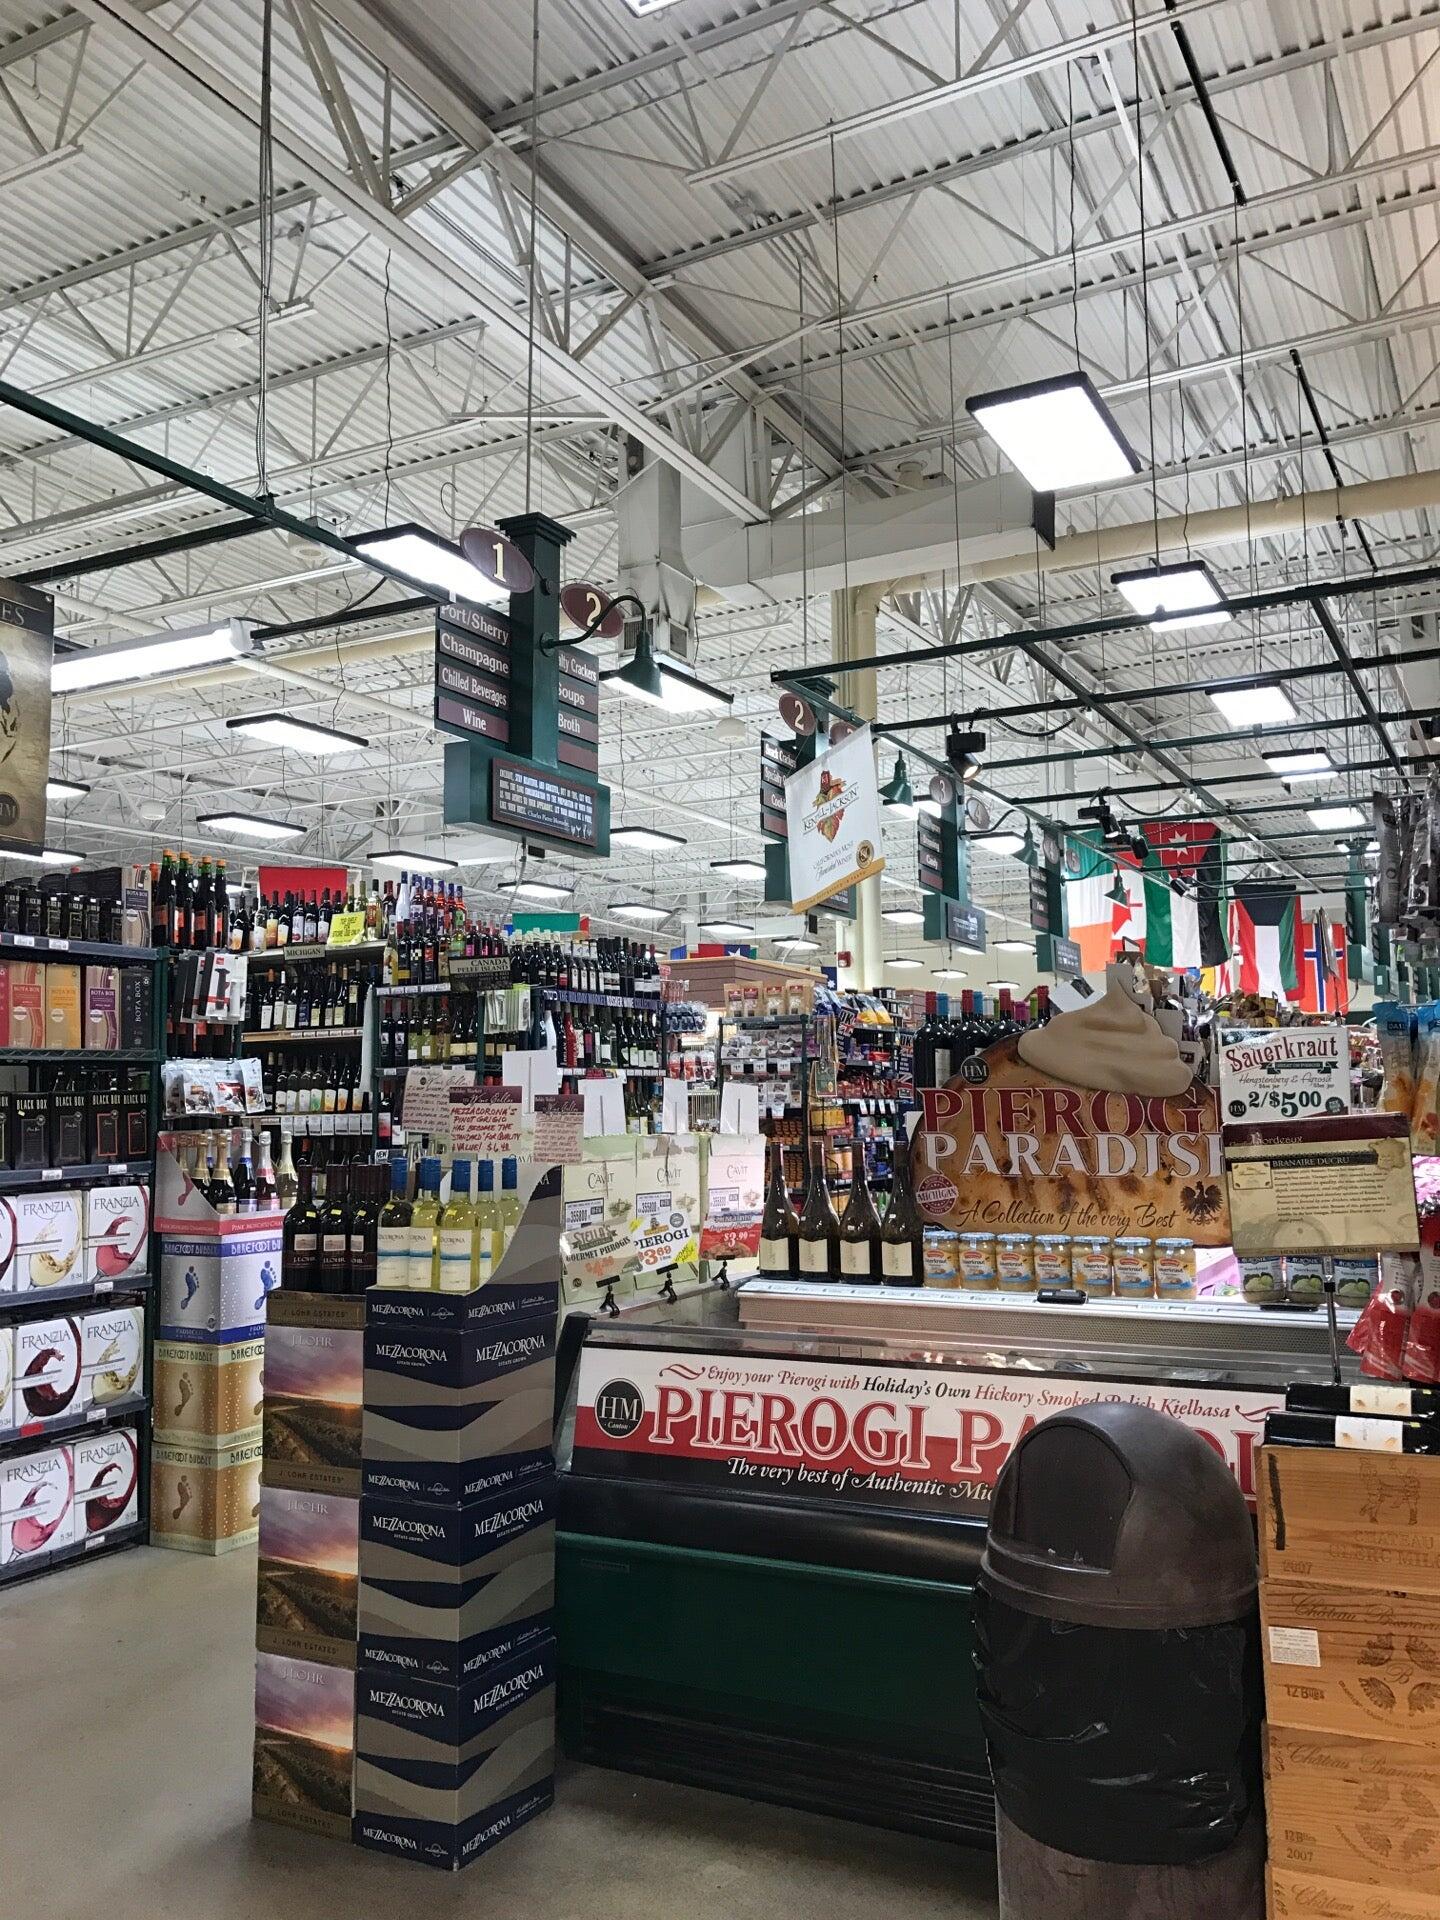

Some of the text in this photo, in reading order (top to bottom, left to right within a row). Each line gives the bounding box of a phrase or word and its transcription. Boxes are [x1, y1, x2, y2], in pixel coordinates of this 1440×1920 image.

[493, 542, 507, 583] 1
[585, 592, 602, 631] 2
[441, 605, 510, 646] Port/Sherry
[440, 632, 510, 675] Champagne
[570, 655, 597, 682] Crackers
[441, 667, 508, 707] Chilled Beverages
[462, 707, 487, 732] Wine
[558, 713, 581, 735] Broth
[793, 700, 805, 731] 2
[771, 793, 786, 809] Cooki
[939, 779, 946, 804] 3
[286, 948, 322, 957] MICHIGAN
[134, 981, 142, 1022] BOTA BOX
[1225, 1036, 1339, 1073] Sauerkraut
[964, 1064, 988, 1078] HM
[1239, 1073, 1290, 1087] Hengstenberg
[16, 1099, 48, 1110] BLACK BOX
[55, 1096, 85, 1107] BLACK BOX
[92, 1095, 121, 1105] BLACK BOX
[123, 1095, 139, 1105] BLACK
[454, 1116, 476, 1124] PINOT
[917, 1086, 1223, 1139] PIEROGI
[1272, 1156, 1351, 1168] BRANAIRE DUCRU
[93, 1196, 140, 1214] FRANZIA
[917, 1187, 958, 1203] MICHIGAN
[23, 1200, 72, 1220] FRANZIA
[957, 1199, 1180, 1237] A Collection of the very Best
[232, 1240, 270, 1255] BAREFOOT
[600, 1236, 631, 1257] PIEROGIS
[634, 1229, 690, 1249] PIEROGI
[372, 1303, 425, 1319] MEZZACORONA
[467, 1300, 516, 1319] MEZZACORONA
[22, 1329, 71, 1350] FRANZIA
[87, 1319, 134, 1340] FRANZIA
[159, 1348, 190, 1360] BAREFOOT
[231, 1345, 265, 1361] BAREFOO
[375, 1343, 448, 1365] MEZZACORONA
[475, 1334, 546, 1363] MEZZACORONA
[706, 1365, 741, 1386] Enjoy
[742, 1370, 774, 1386] your
[777, 1369, 829, 1391] Pierogi
[829, 1375, 860, 1391] with
[861, 1375, 931, 1400] Holiday's
[935, 1382, 971, 1400] Own
[974, 1384, 1034, 1409] Hickory
[1037, 1389, 1101, 1407] Smoked
[1158, 1397, 1231, 1419] Kielbasa
[598, 1395, 639, 1423] HM
[607, 1420, 628, 1431] Canton
[648, 1384, 931, 1470] PIEROGI
[80, 1440, 127, 1464] FRANZIA
[7, 1458, 61, 1482] FRANZIA
[727, 1456, 945, 1497] The very best of Authentic
[368, 1473, 420, 1491] MEZZACORONA
[464, 1470, 513, 1494] MEZZACORONA
[372, 1514, 446, 1541] MEZZACORONA
[474, 1499, 544, 1539] MEZZACORONA
[365, 1648, 418, 1669] MEZZACORONA
[463, 1641, 512, 1673] MEZZACORONA
[473, 1664, 544, 1714] MEZZACORONA
[369, 1689, 445, 1718] MEZZACORONA
[363, 1826, 418, 1850] MEZZACORONA
[462, 1816, 511, 1856] MEZZACORONA
[1286, 1847, 1314, 1863] 2007
